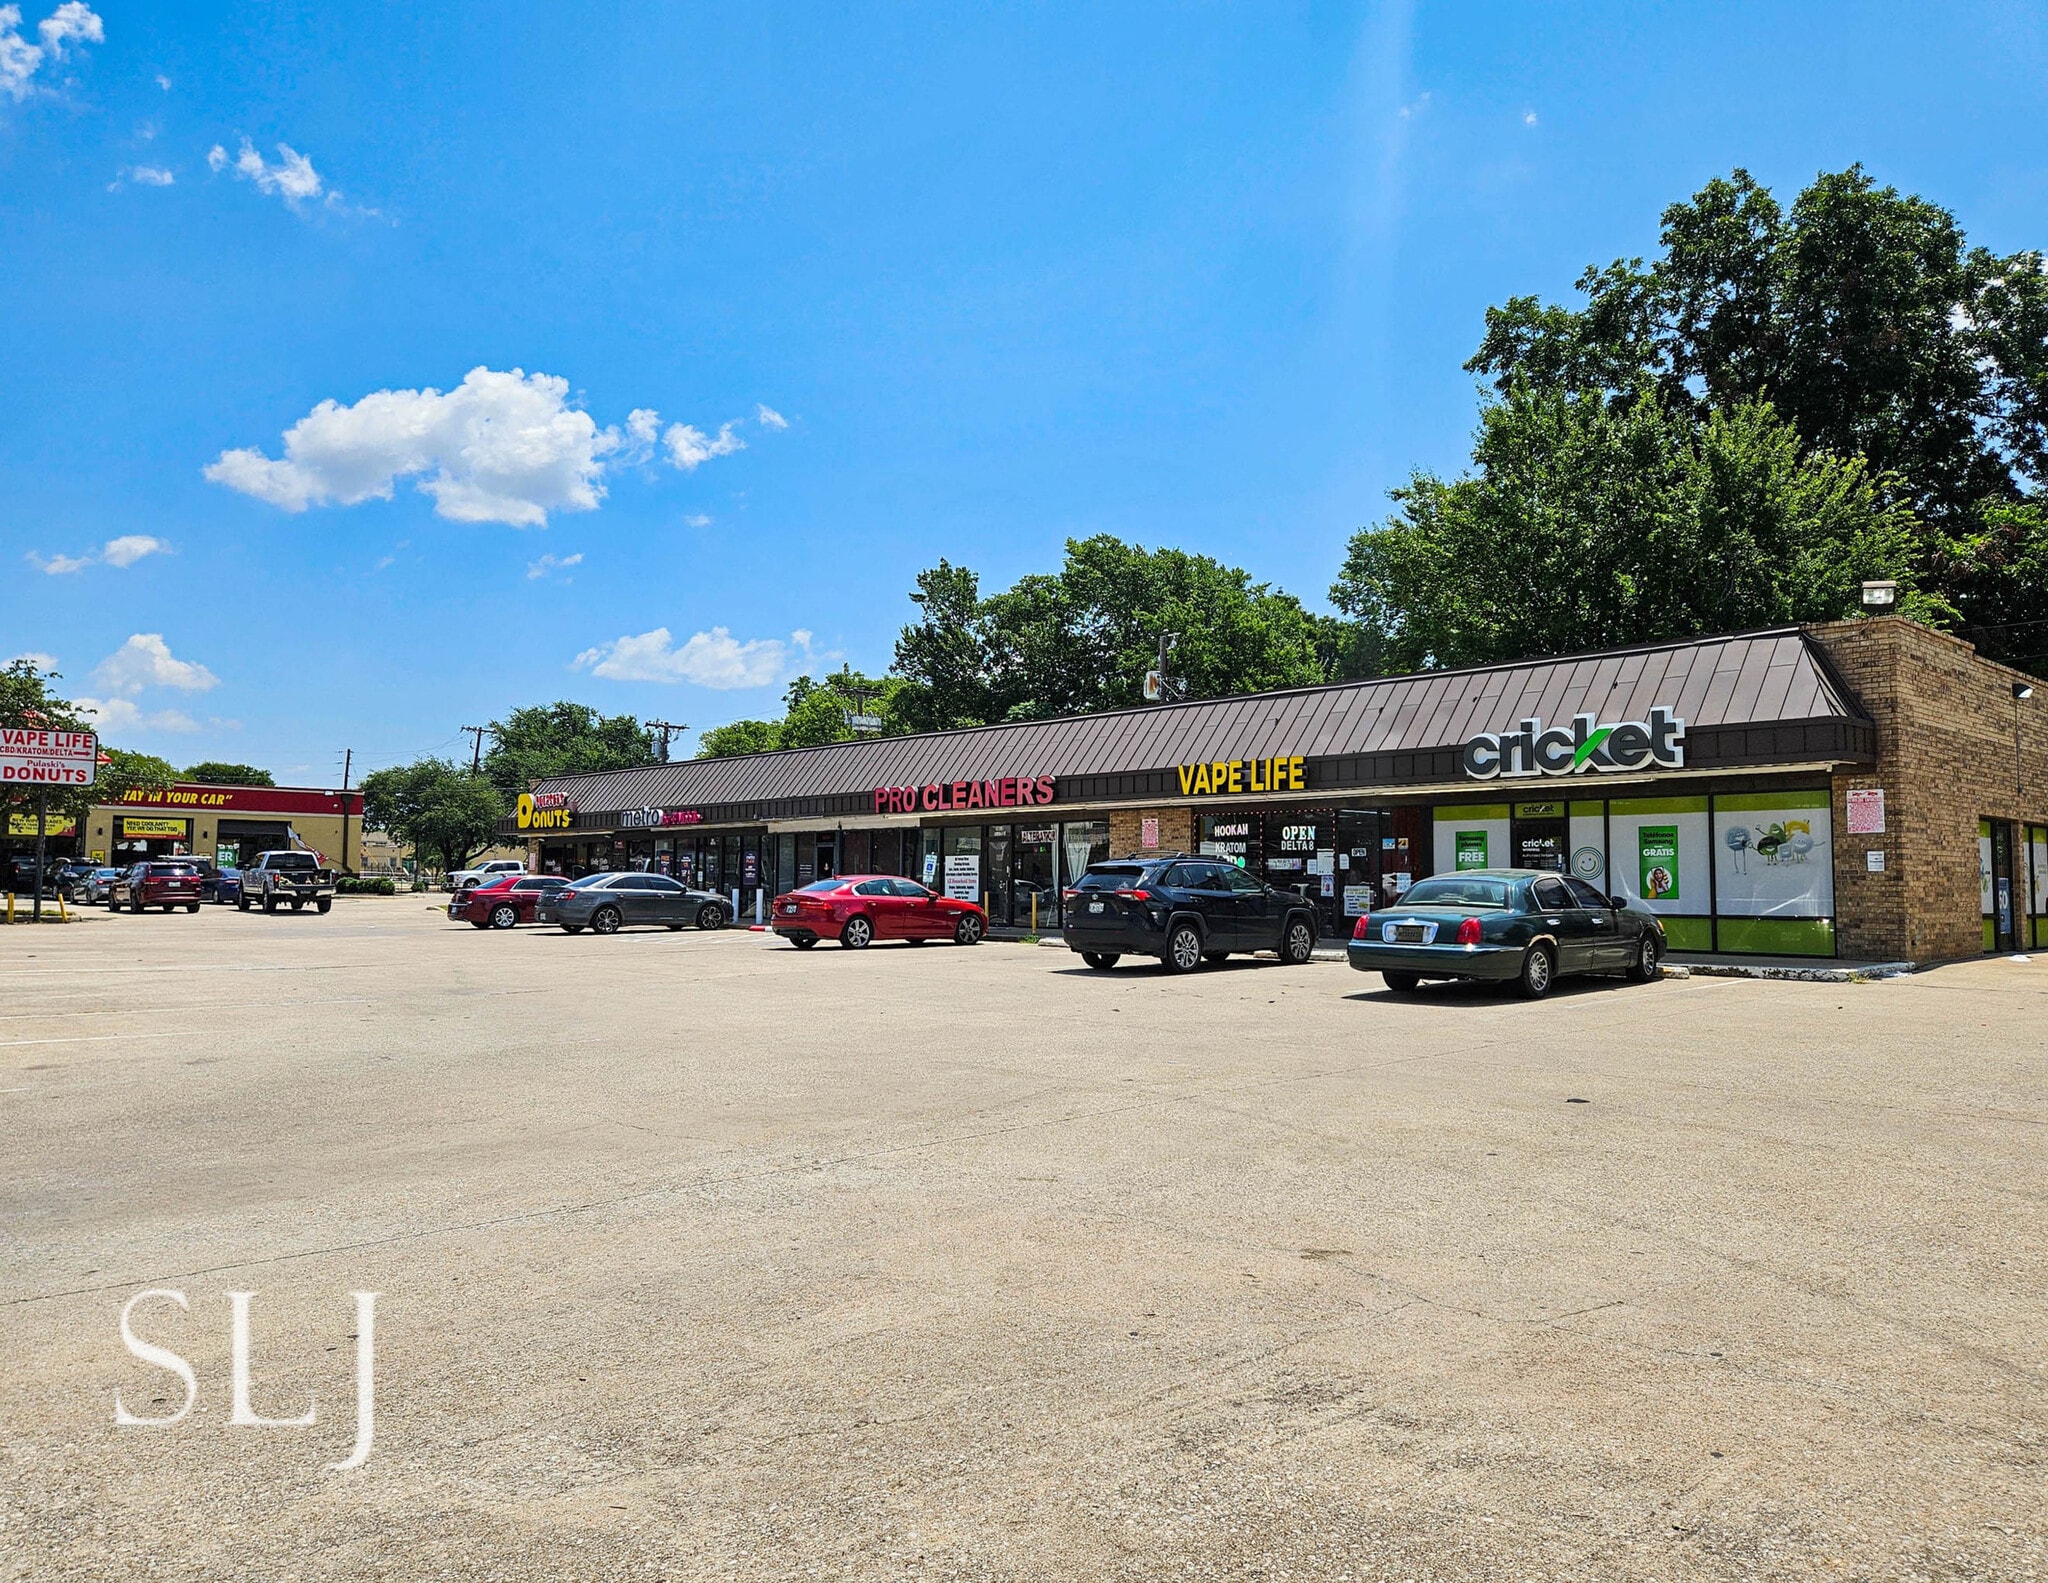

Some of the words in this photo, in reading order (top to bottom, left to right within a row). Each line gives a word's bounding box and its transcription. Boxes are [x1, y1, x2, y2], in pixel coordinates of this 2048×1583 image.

[2, 729, 49, 747] VAPE
[54, 732, 93, 749] LIFE
[1464, 705, 1685, 780] cricket
[0, 745, 15, 754] CBD
[16, 746, 49, 756] KRATOM
[50, 748, 74, 757] DELTA
[26, 759, 66, 769] Pulaski's
[3, 765, 87, 783] DONUTS
[1178, 759, 1243, 795] VAPE
[1250, 755, 1305, 791] LIFE
[166, 791, 199, 804] YOUR
[874, 785, 917, 814] PRO
[922, 775, 1056, 811] CLEANERS
[1522, 804, 1555, 814] cricket
[622, 805, 663, 828] metro
[1214, 823, 1249, 837] HOOKAH
[1282, 825, 1316, 840] OPEN
[1215, 841, 1247, 853] KRATOM
[1281, 840, 1308, 851] DELTA
[1308, 841, 1315, 850] 8
[1522, 838, 1555, 848] cricket
[1458, 852, 1485, 862] FREE
[1642, 848, 1675, 857] GRATIS
